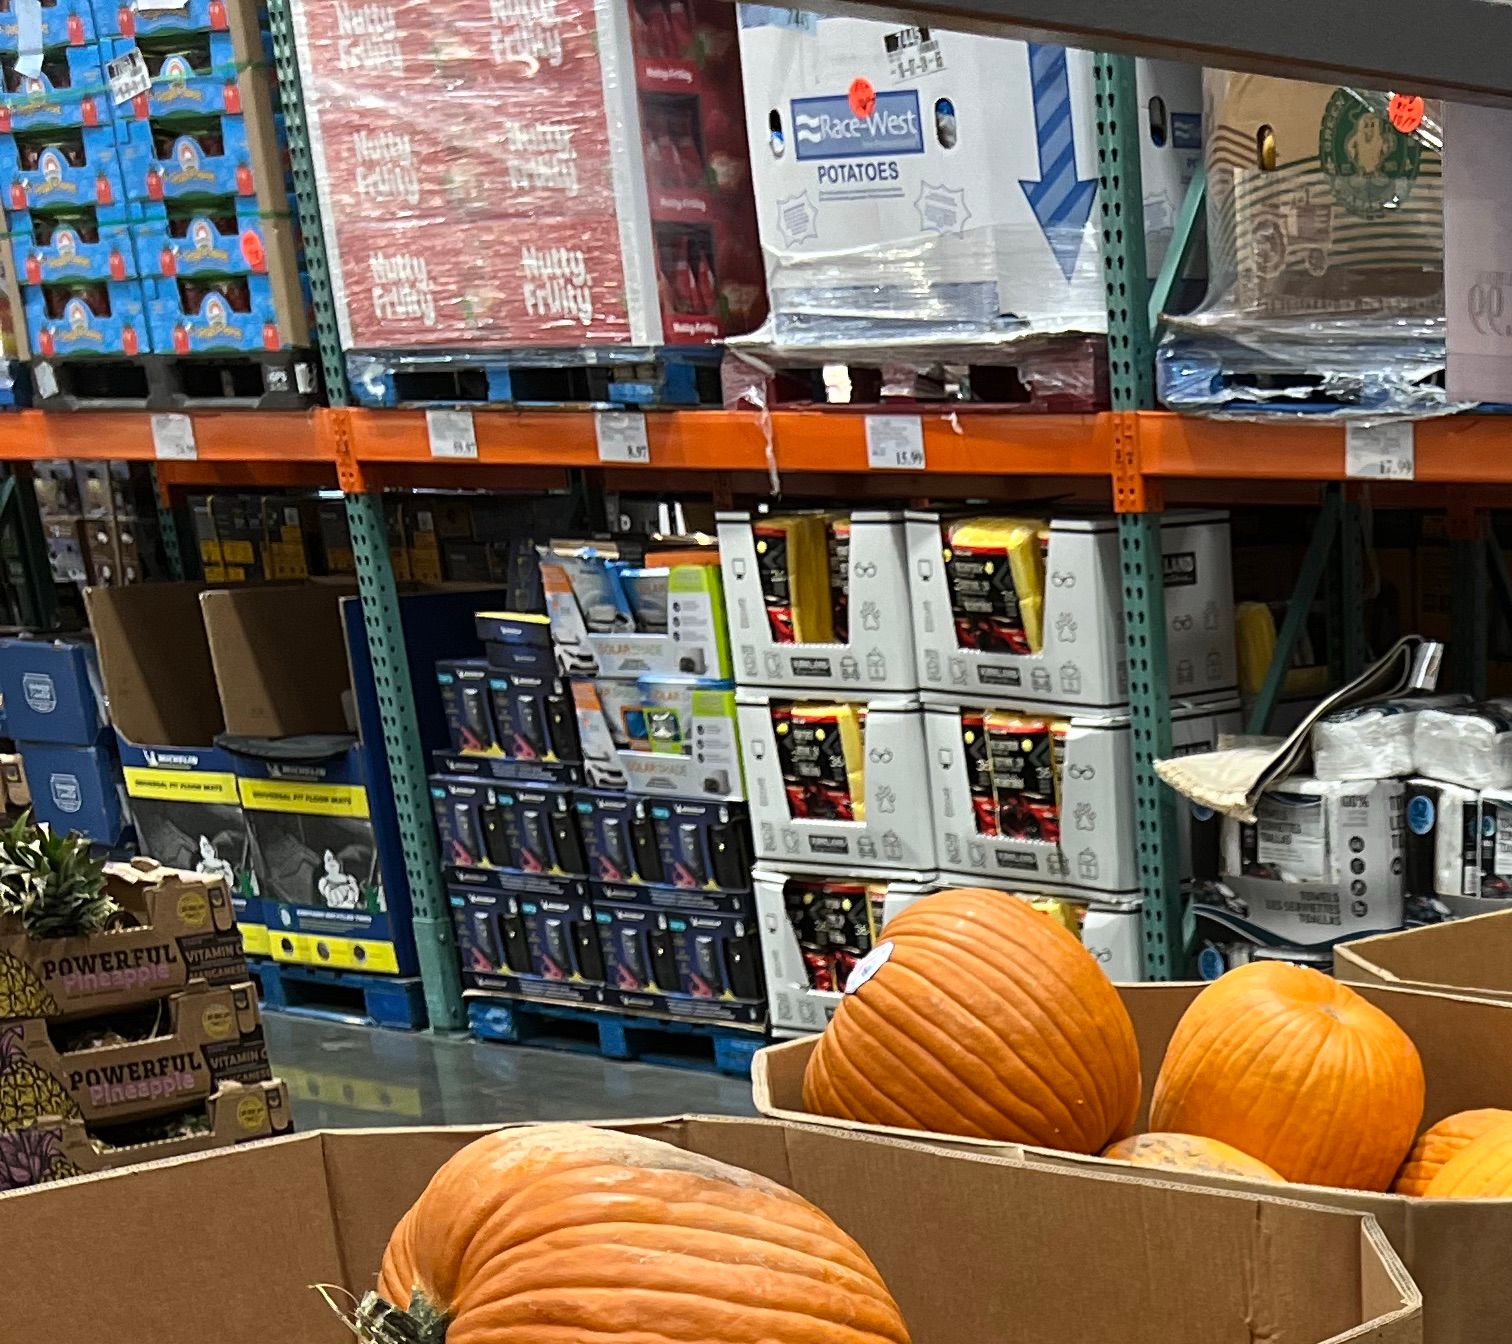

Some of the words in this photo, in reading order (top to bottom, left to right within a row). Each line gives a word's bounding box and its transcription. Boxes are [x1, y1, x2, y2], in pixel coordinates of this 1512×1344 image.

[820, 110, 919, 141] Race-West
[817, 161, 900, 184] POTATOES
[520, 246, 593, 286] Nutty
[523, 280, 593, 326] Fruity
[43, 944, 178, 981] POWERFUL
[184, 946, 235, 964] VITAMIN
[61, 963, 171, 994] Pineapple
[68, 1052, 202, 1091] POWERFUL
[208, 1052, 259, 1070] VITAMIN
[89, 1072, 196, 1106] Pineapple
